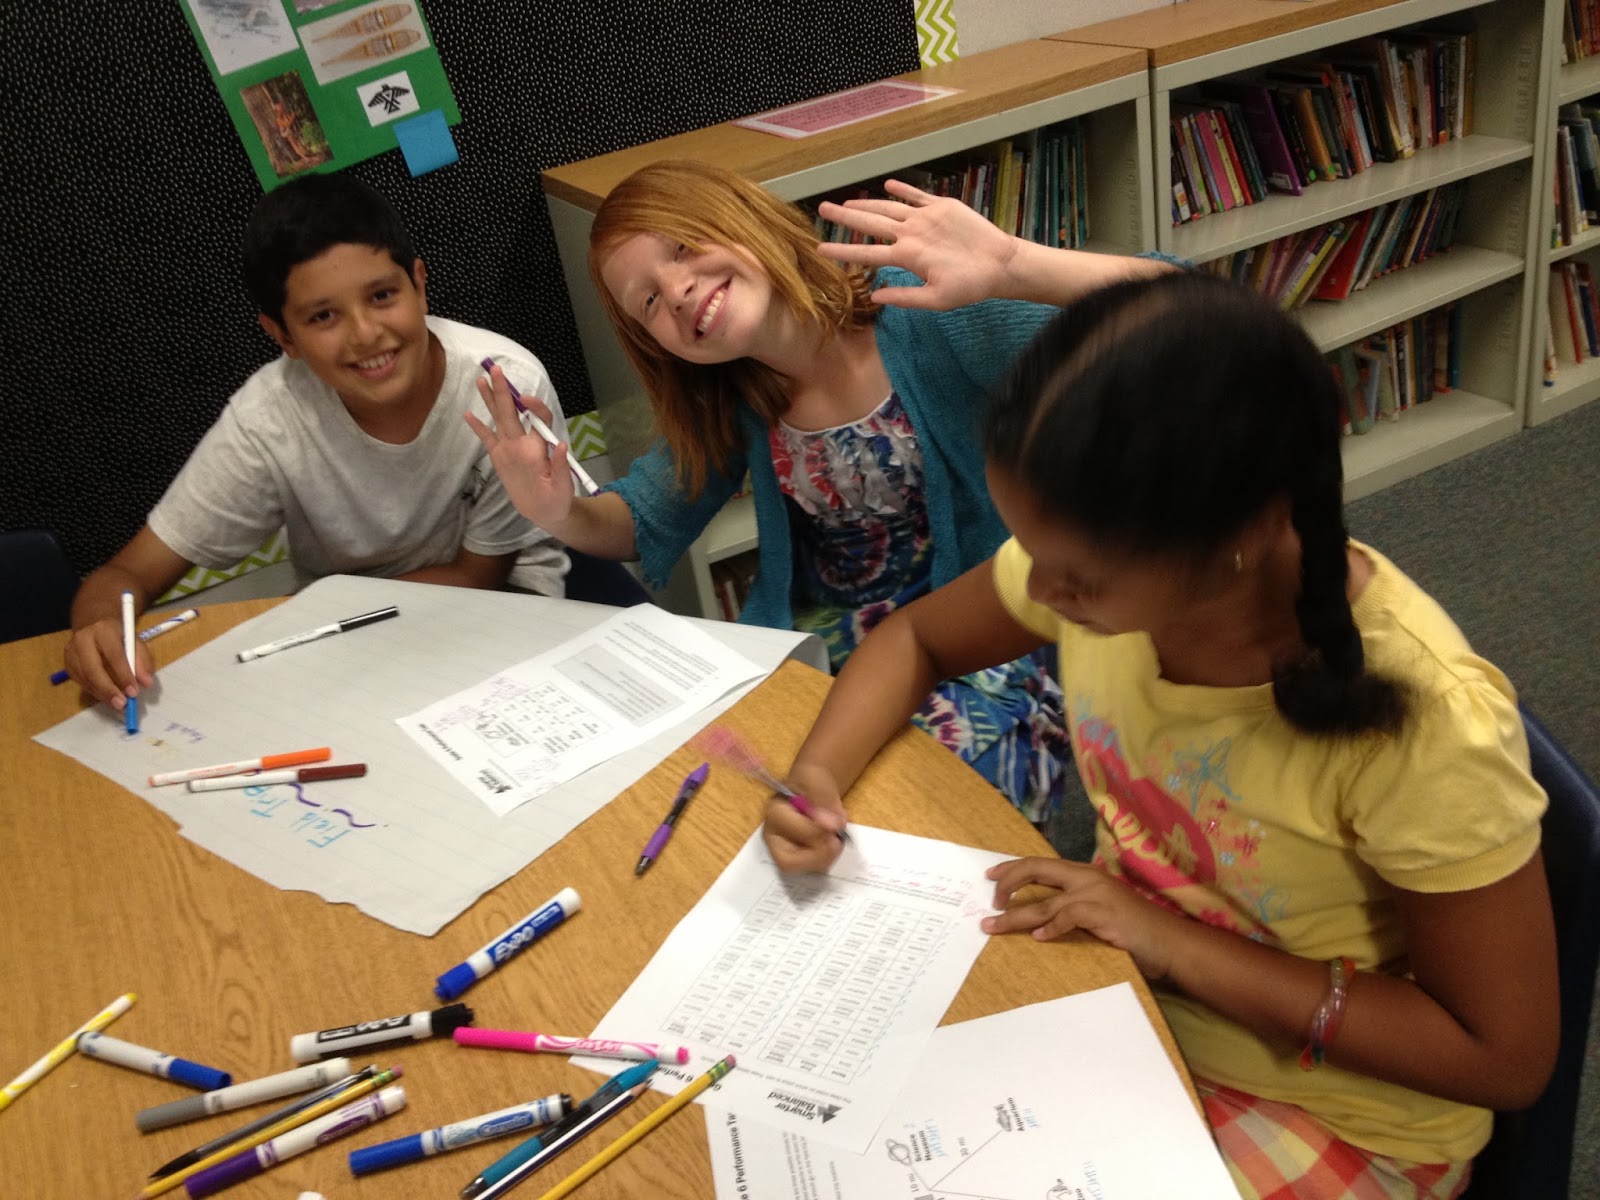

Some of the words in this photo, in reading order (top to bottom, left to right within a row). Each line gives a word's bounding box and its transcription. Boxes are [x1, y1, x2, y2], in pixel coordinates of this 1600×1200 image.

[767, 1091, 816, 1111] Balanced
[774, 1102, 816, 1121] Smarter
[1007, 1097, 1025, 1131] Aquarium
[730, 1127, 747, 1183] Performance
[919, 1130, 932, 1161] Museum
